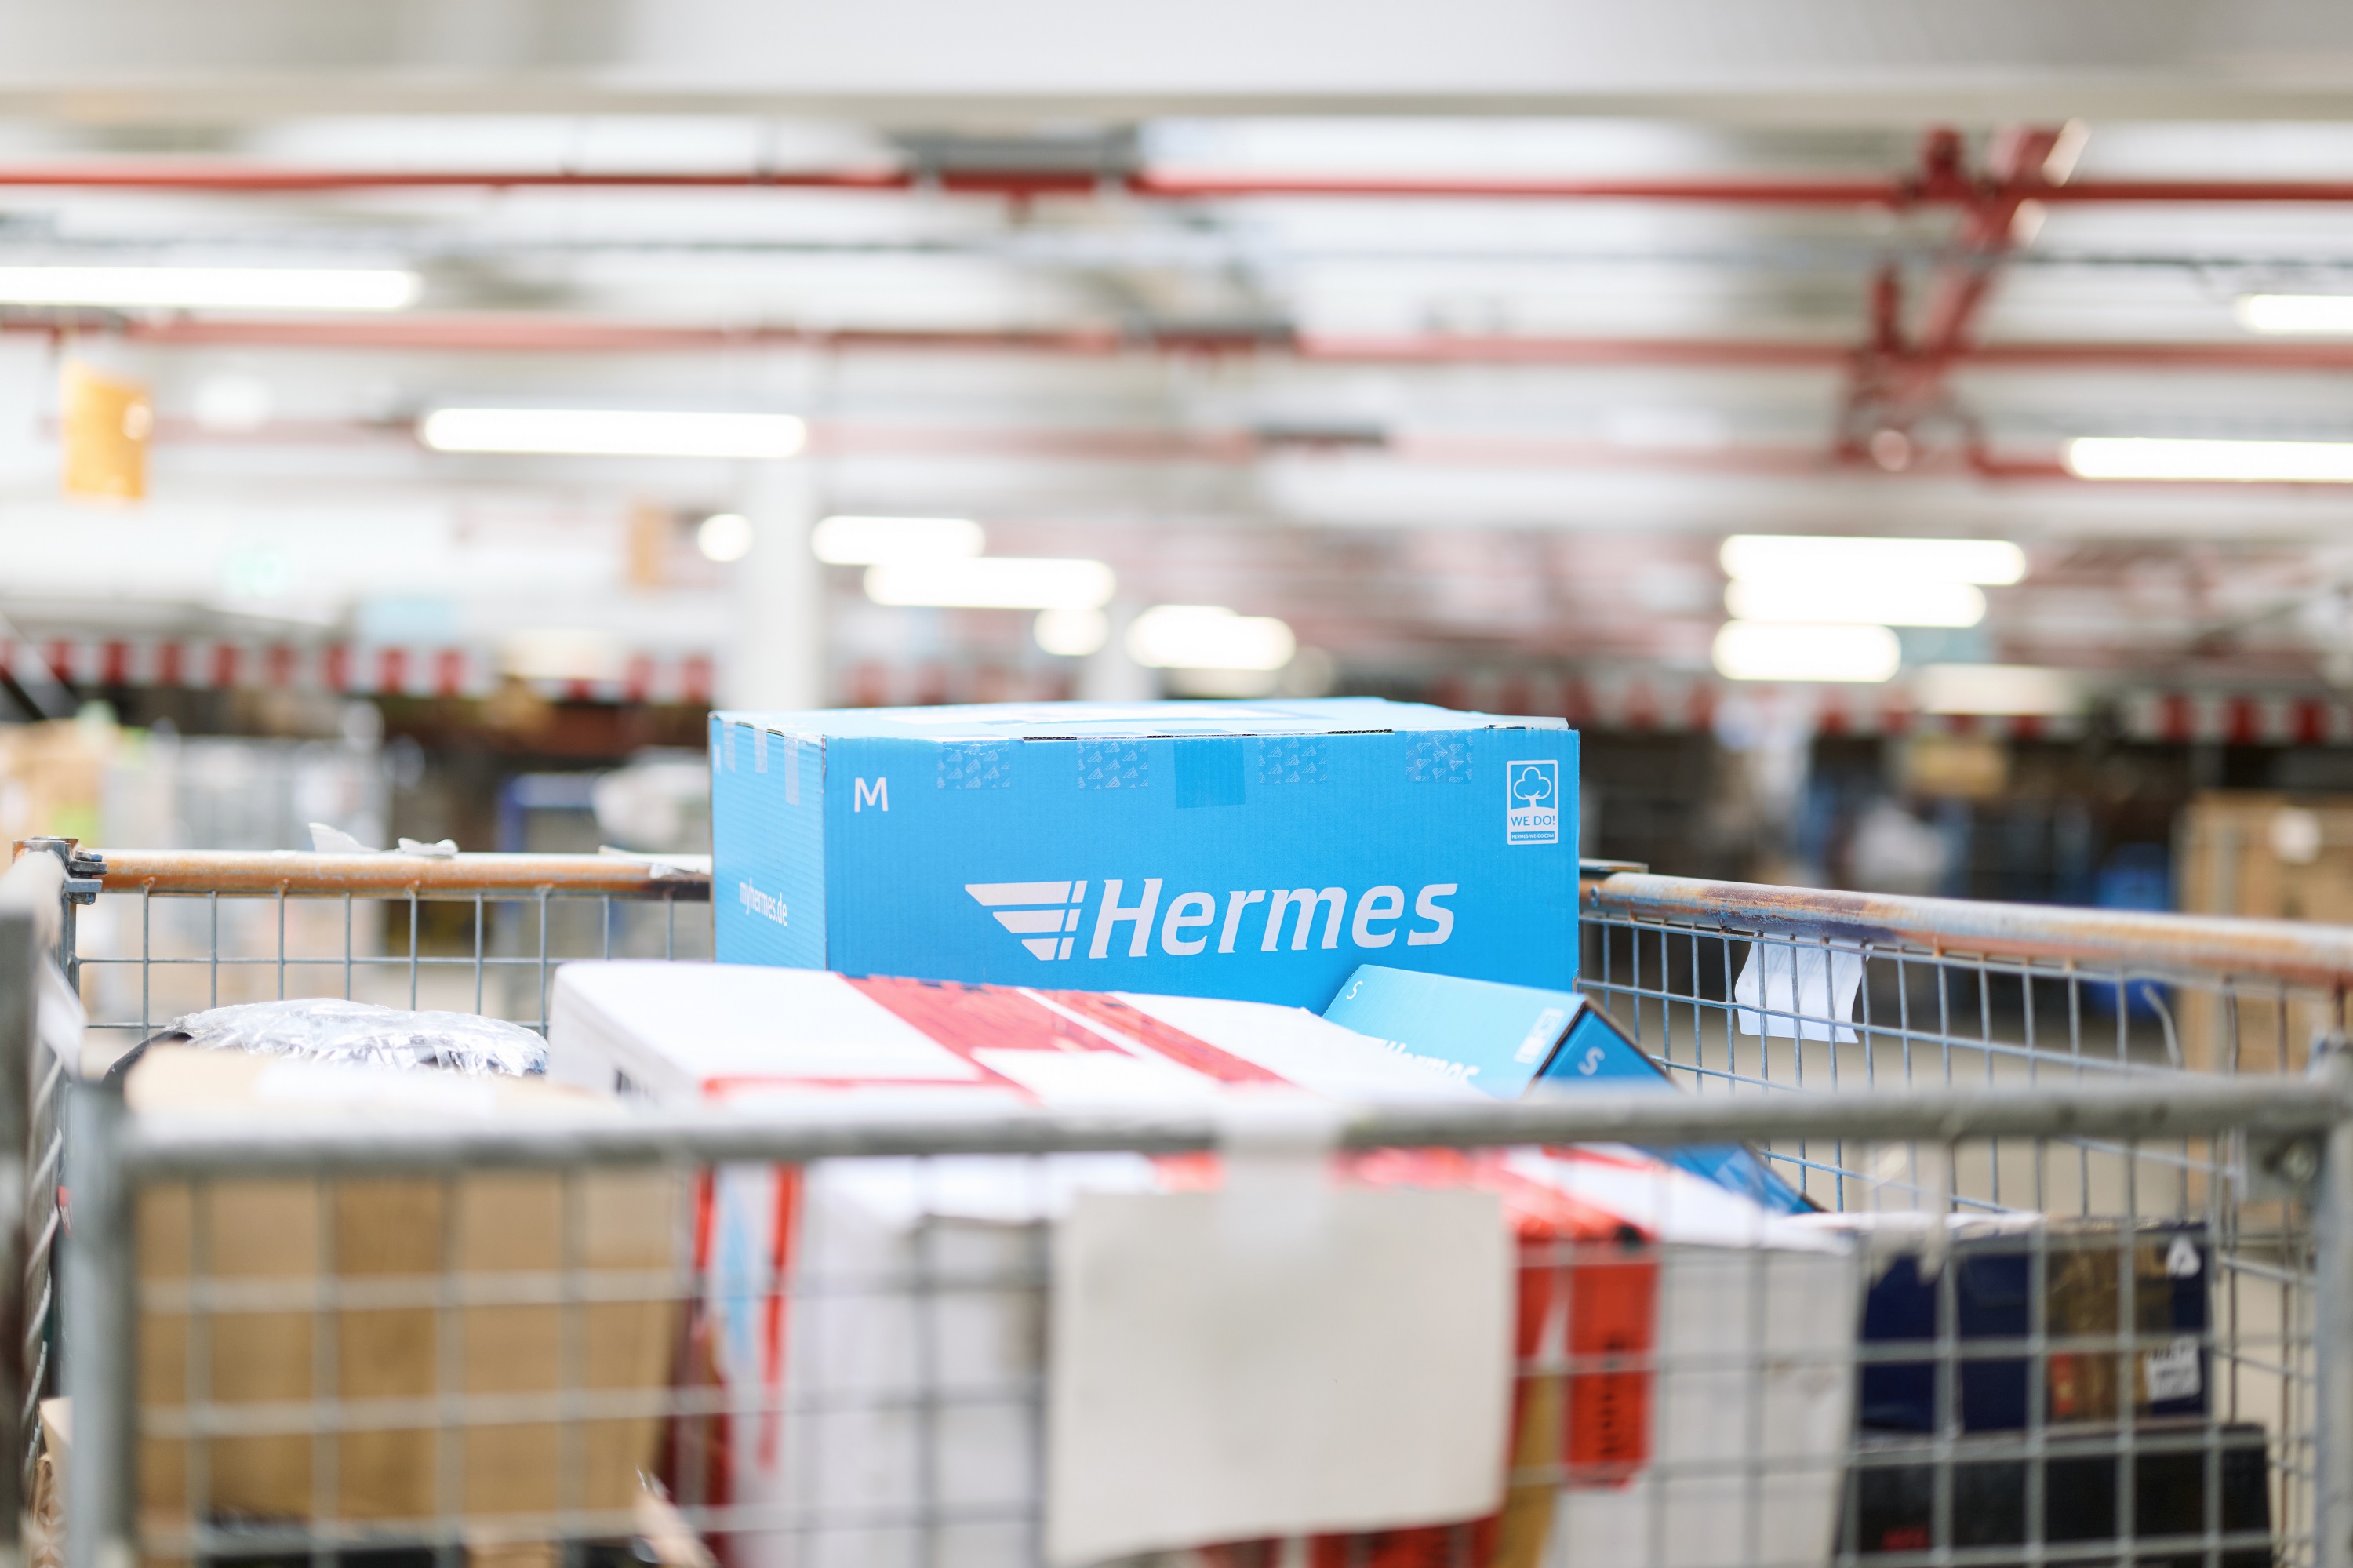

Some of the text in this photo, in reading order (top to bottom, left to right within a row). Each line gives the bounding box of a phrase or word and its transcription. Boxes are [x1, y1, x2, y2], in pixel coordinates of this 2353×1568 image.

[854, 777, 889, 813] M
[1511, 815, 1555, 826] WE DO!
[740, 878, 787, 927] myhermes.de
[1089, 878, 1459, 959] Hermes
[1346, 980, 1363, 1000] S
[1577, 1046, 1606, 1076] S
